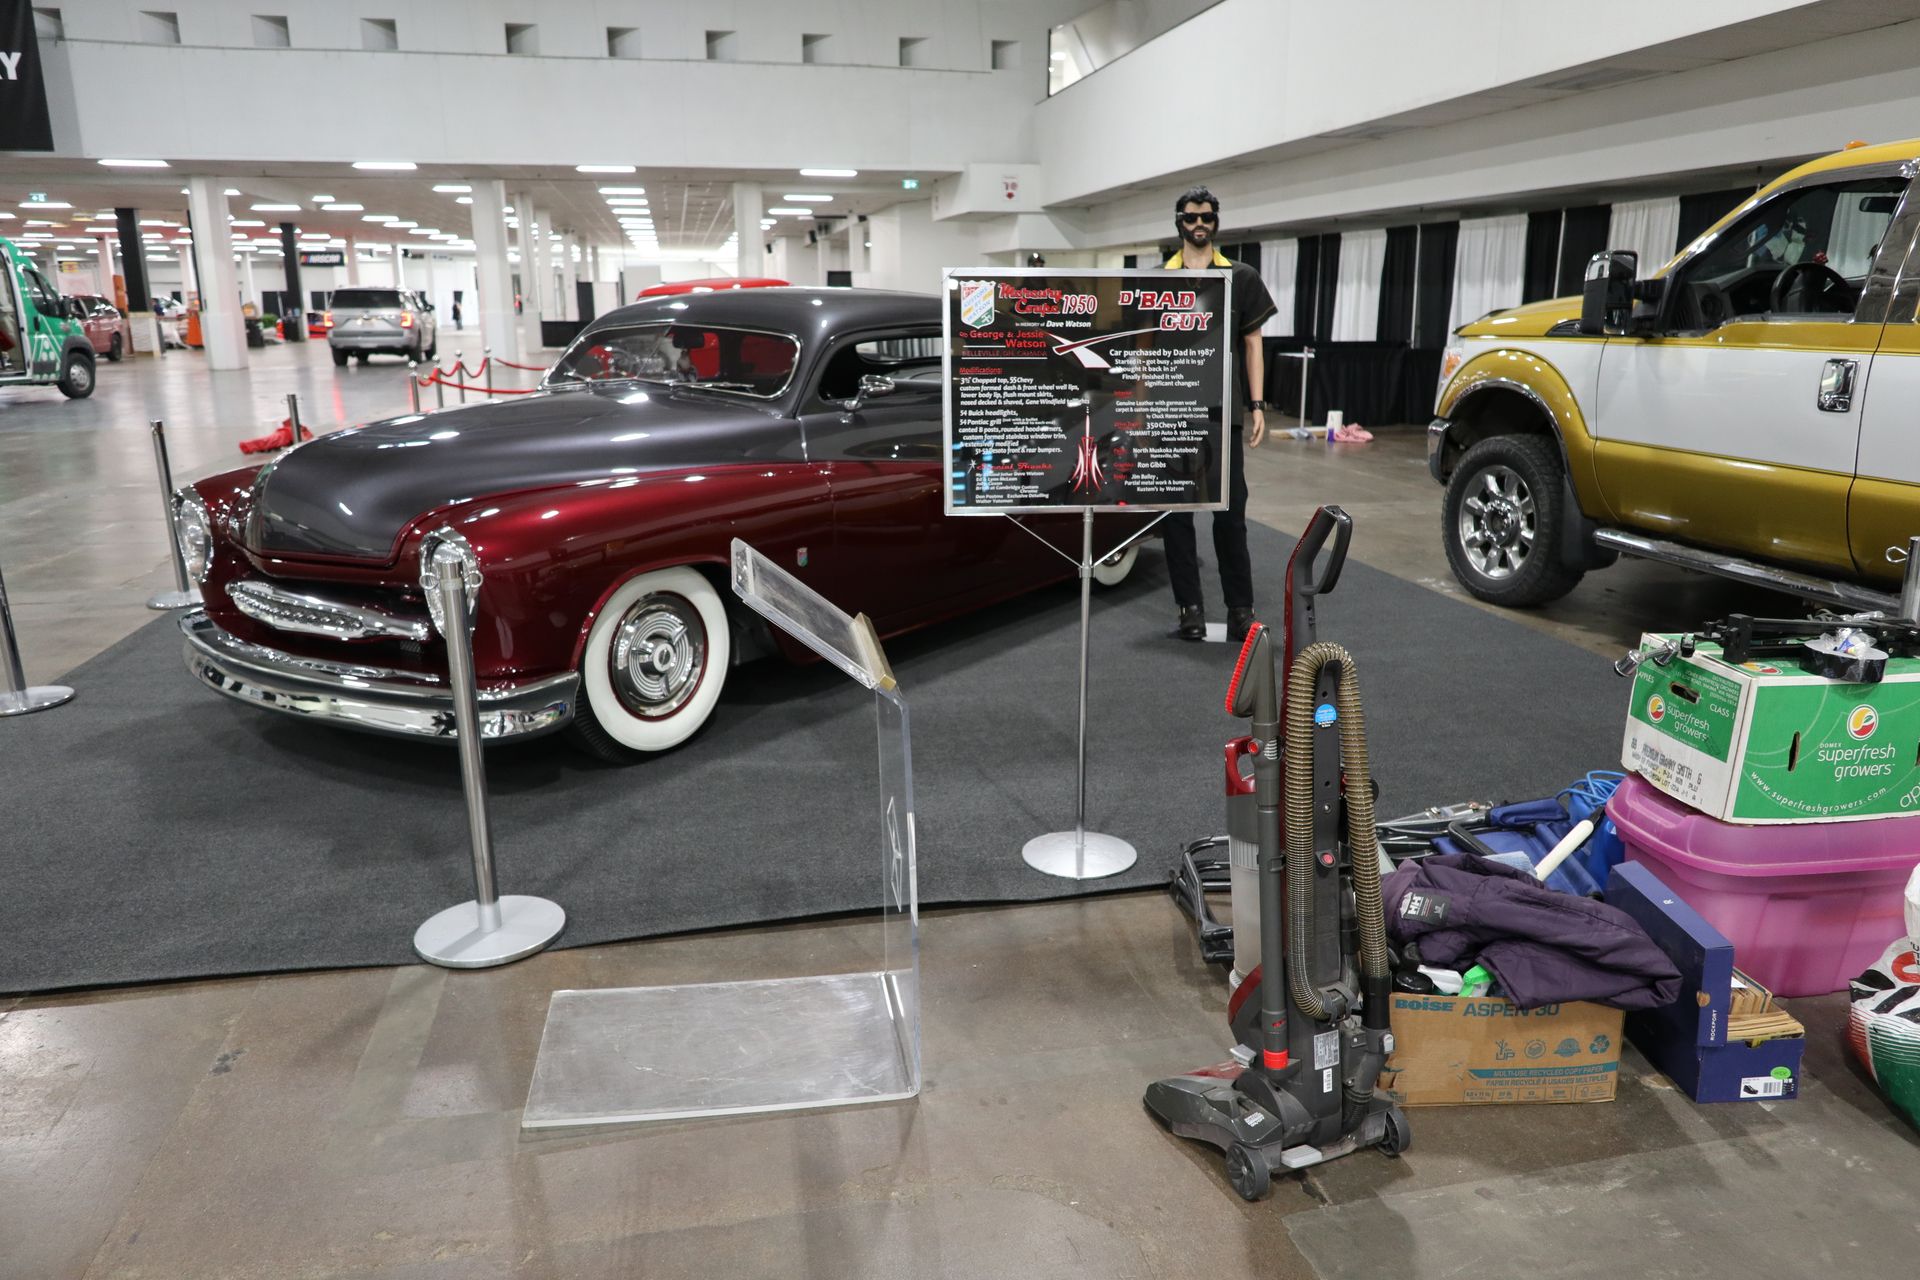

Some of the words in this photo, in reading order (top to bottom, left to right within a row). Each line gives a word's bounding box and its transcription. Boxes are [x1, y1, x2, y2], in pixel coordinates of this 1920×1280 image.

[0, 51, 22, 80] Y
[1062, 294, 1098, 315] 1950
[1046, 320, 1064, 328] Dave
[1065, 320, 1091, 328] Watson
[1160, 312, 1213, 331] GUY
[970, 330, 1004, 340] George
[1017, 330, 1045, 339] Jessie
[1005, 339, 1047, 348] Watson
[1123, 348, 1161, 358] purchased
[1162, 348, 1172, 358] by
[1189, 348, 1197, 356] in
[972, 377, 996, 386] Chopped
[1017, 377, 1034, 386] Chevy
[1145, 380, 1173, 389] significant
[1174, 381, 1199, 389] changes!
[981, 385, 1001, 393] formed
[1023, 384, 1037, 393] front
[978, 392, 992, 400] body
[1002, 392, 1017, 400] flush
[990, 418, 1001, 426] grill
[1147, 422, 1159, 430] 350
[1160, 421, 1177, 429] Chevy
[1178, 421, 1187, 429] V8
[965, 441, 994, 449] extensively
[1007, 446, 1021, 455] front
[1173, 447, 1198, 455] Autobody
[1638, 671, 1655, 684] APPLES
[1709, 703, 1730, 718] CLASS
[1667, 705, 1710, 731] superfresh
[1674, 721, 1708, 741] growers
[1817, 743, 1896, 765] superfresh
[1834, 763, 1892, 782] growers
[1751, 771, 1887, 815] www.superfreshgrowers.com
[1710, 1009, 1718, 1040] ROCKPORT
[1529, 1068, 1564, 1077] RECYCLED
[1583, 1065, 1604, 1073] PAPER
